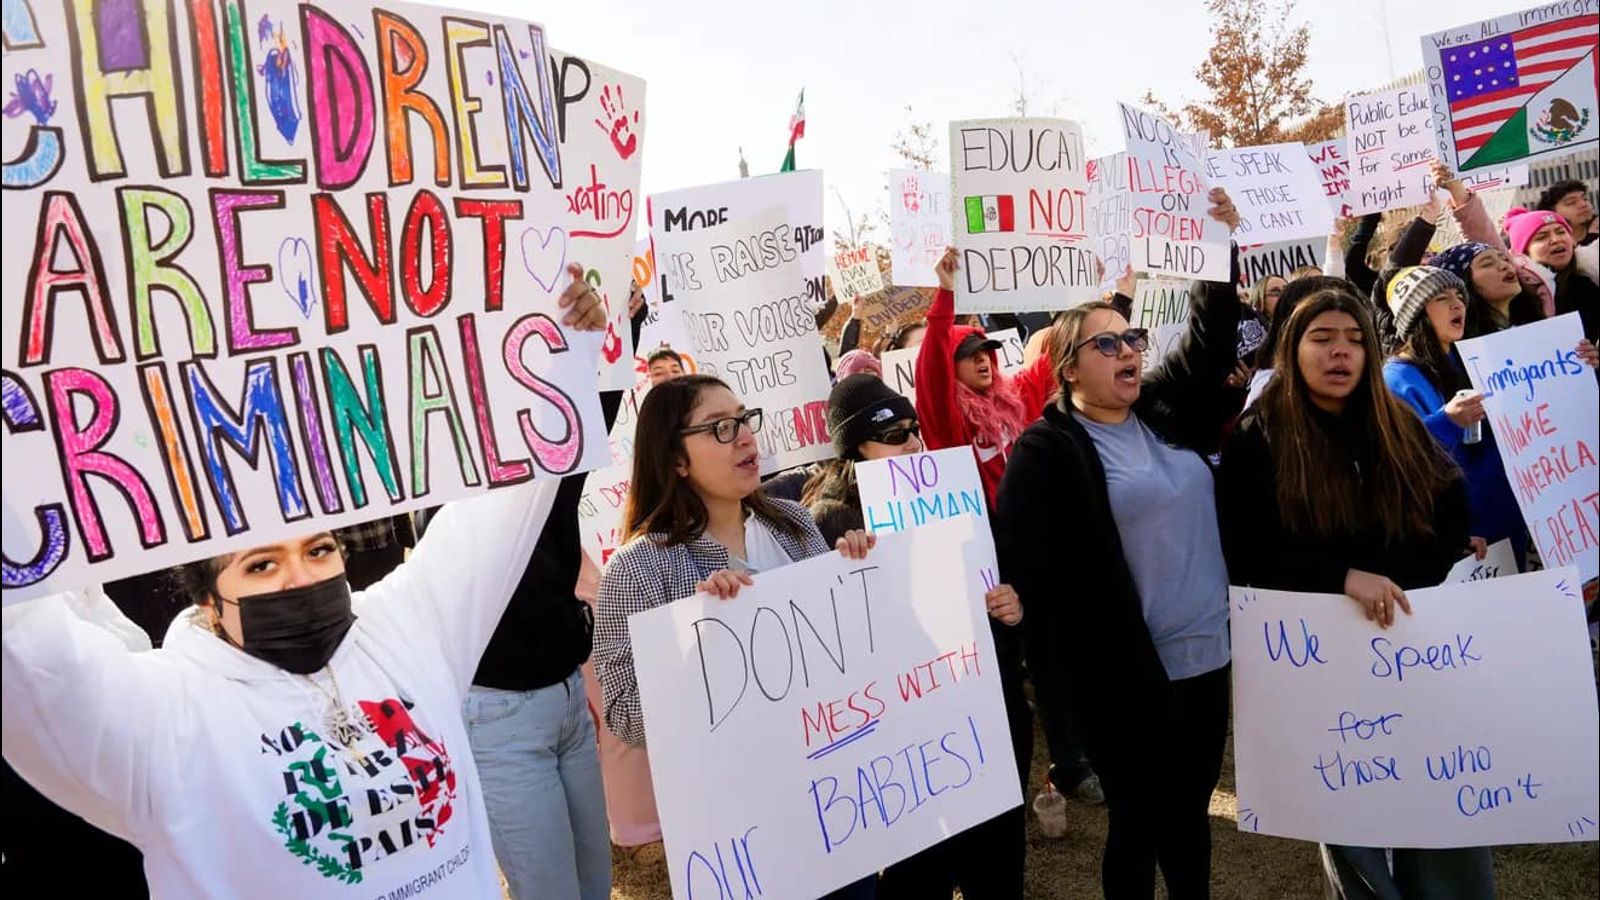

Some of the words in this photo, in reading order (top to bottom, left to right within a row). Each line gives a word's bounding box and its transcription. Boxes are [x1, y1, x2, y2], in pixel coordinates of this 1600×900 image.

[1349, 101, 1394, 130] Public
[1399, 91, 1429, 116] Educ
[961, 128, 1079, 172] EDUCAT
[1309, 145, 1341, 164] WE
[1355, 130, 1387, 152] NOT
[1398, 123, 1417, 138] be
[1163, 147, 1181, 169] IS
[1231, 152, 1293, 177] SPEAK
[1321, 160, 1349, 181] NAT
[1359, 155, 1381, 176] for
[1029, 188, 1086, 232] NOT
[1161, 193, 1189, 211] ON
[1241, 185, 1297, 207] THOSE
[1361, 184, 1406, 209] right
[1134, 207, 1204, 241] STOLEN
[711, 224, 796, 283] RAISE
[1147, 237, 1205, 274] LAND
[20, 186, 300, 367] ARE
[311, 189, 524, 334] NOT
[734, 294, 816, 347] VOICES
[1140, 288, 1190, 330] HAND
[727, 350, 796, 395] THE
[887, 454, 939, 497] NO
[692, 566, 879, 732] DON'T
[1264, 618, 1328, 668] We
[802, 681, 886, 747] MESS
[897, 641, 981, 702] WITH
[1328, 711, 1403, 743] for
[809, 716, 986, 854] BABIES!
[1313, 750, 1401, 791] those
